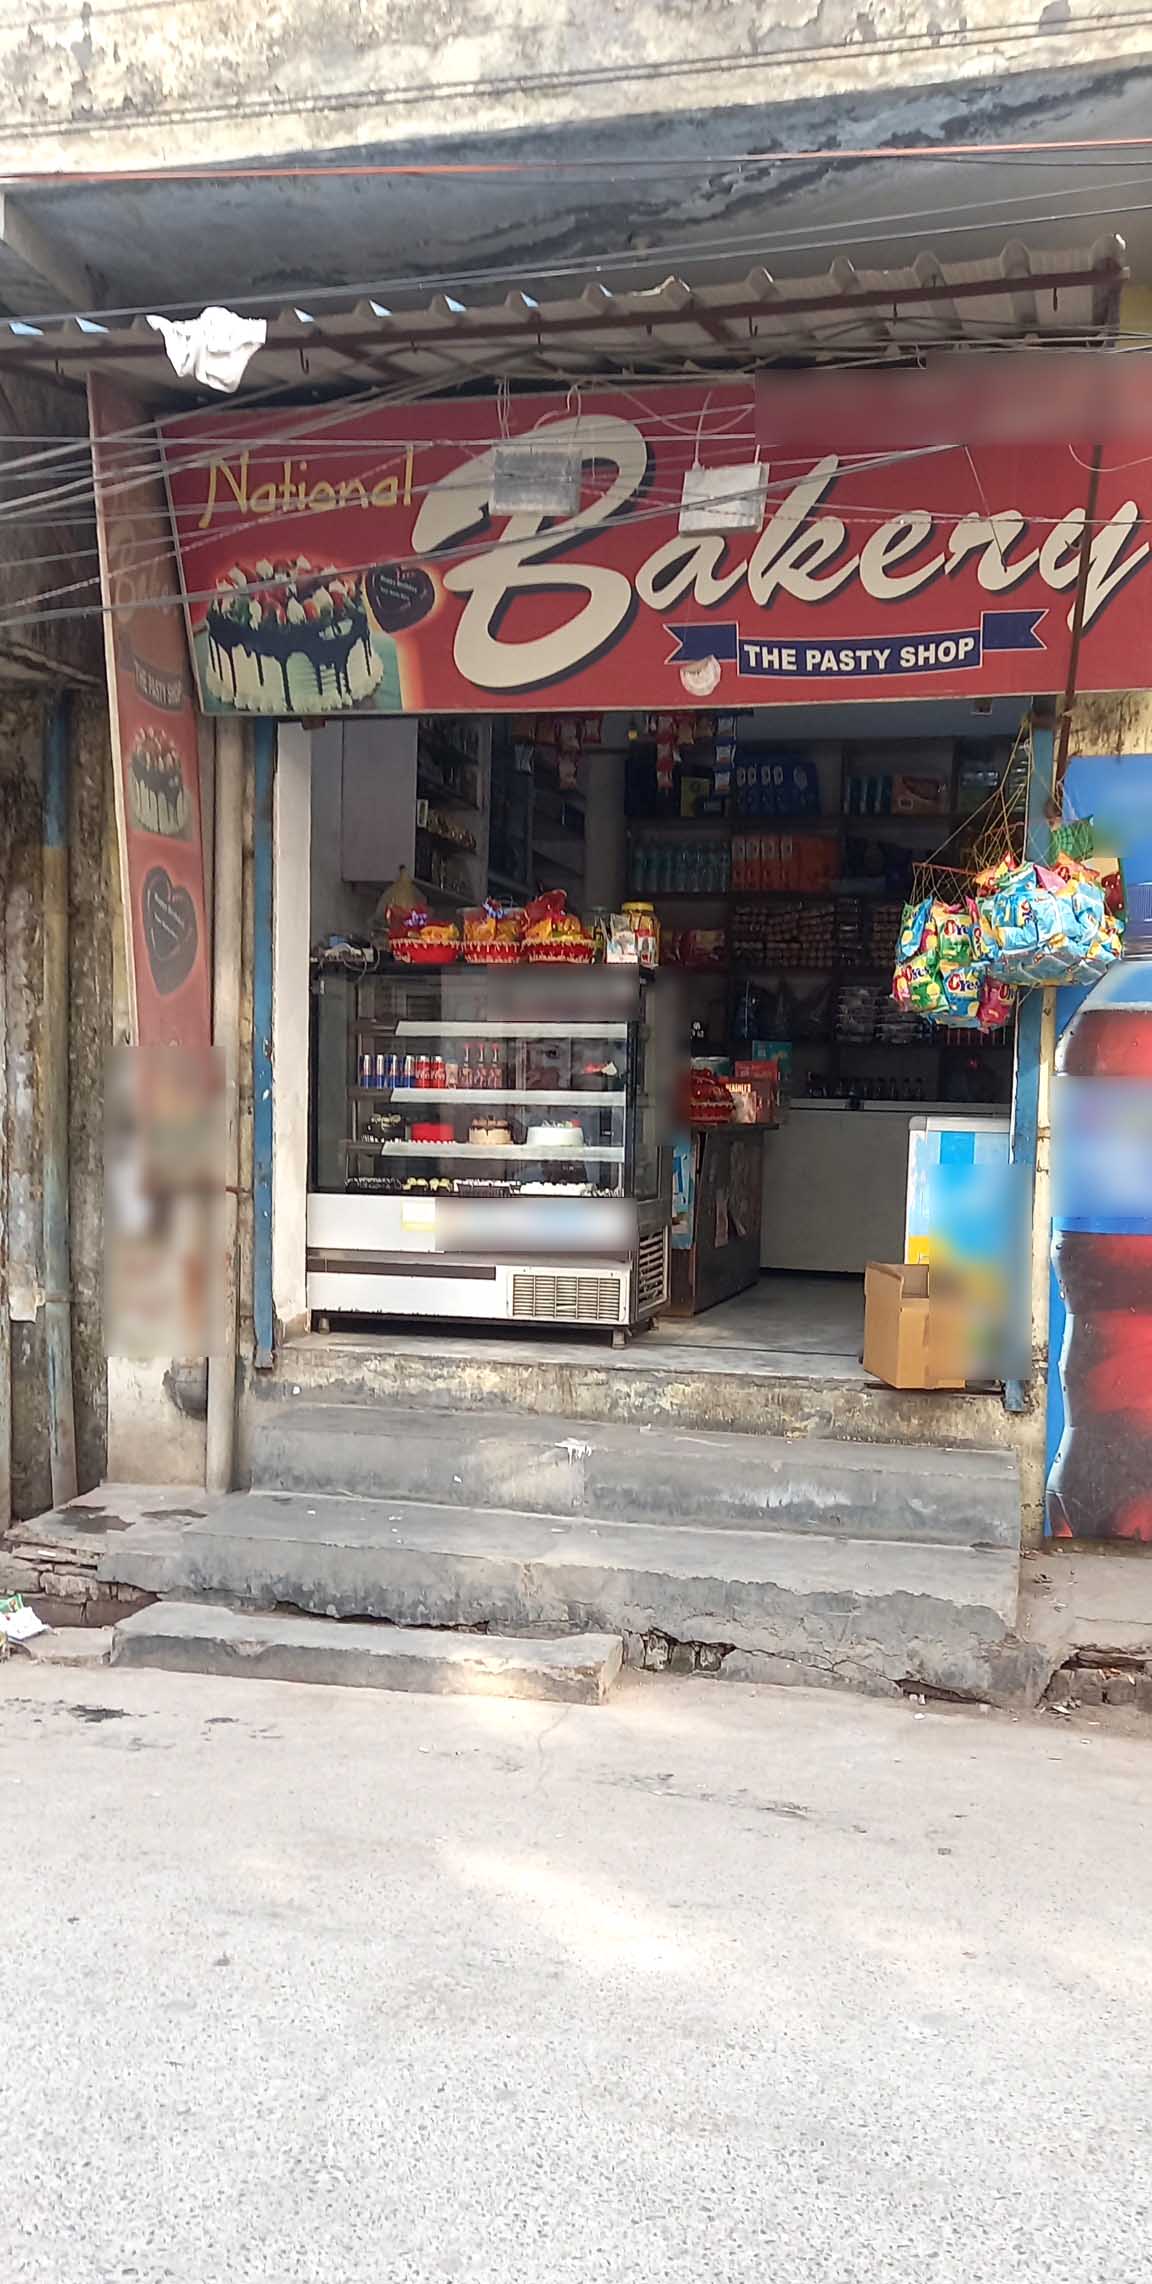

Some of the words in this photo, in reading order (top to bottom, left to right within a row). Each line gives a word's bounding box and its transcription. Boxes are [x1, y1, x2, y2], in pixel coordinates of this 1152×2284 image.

[199, 444, 414, 528] National
[411, 414, 1150, 690] Bakery
[743, 644, 797, 671] THE
[806, 648, 892, 671] PASTY
[899, 636, 975, 668] SHOP
